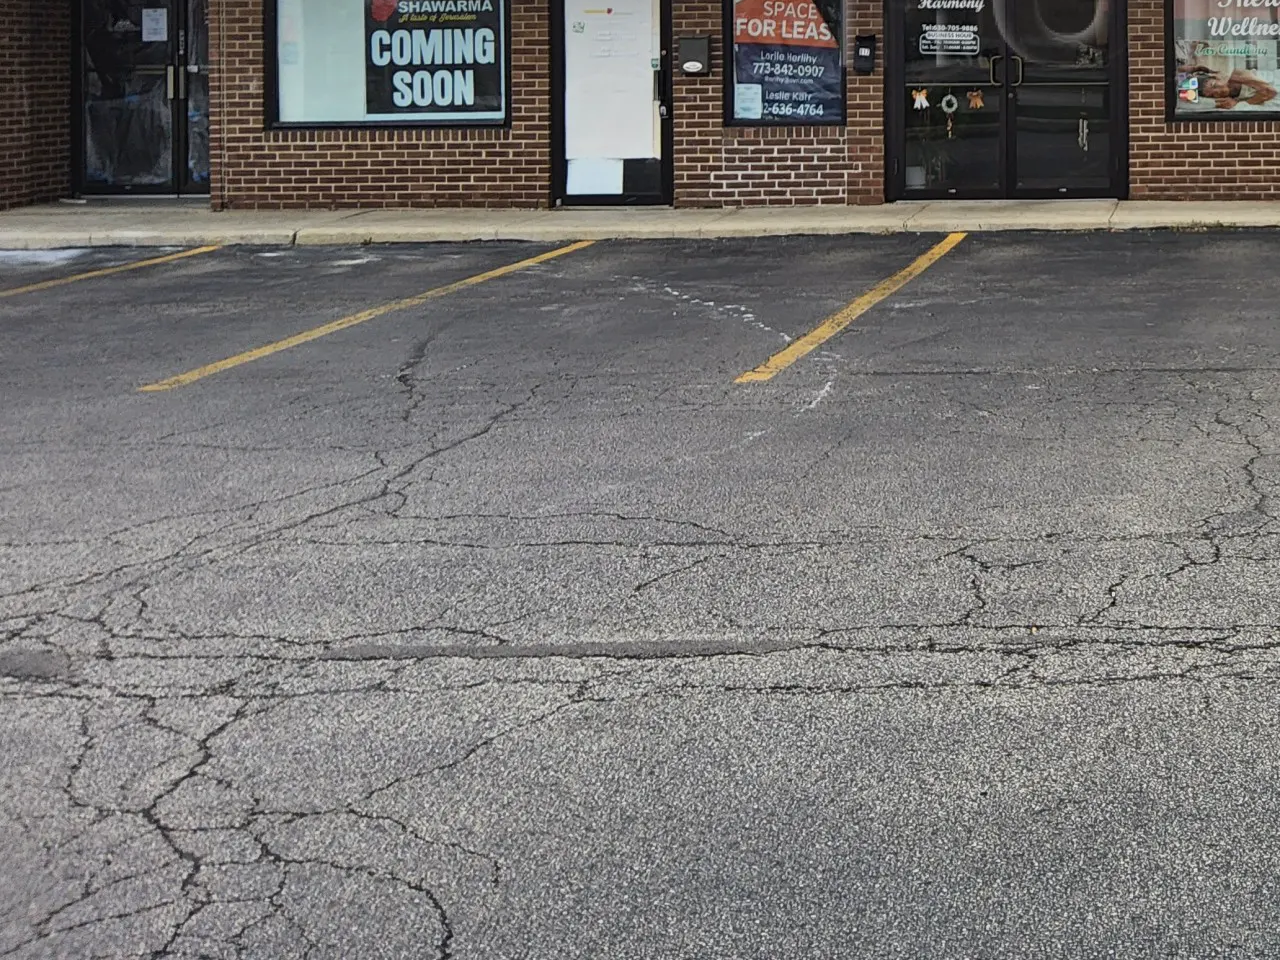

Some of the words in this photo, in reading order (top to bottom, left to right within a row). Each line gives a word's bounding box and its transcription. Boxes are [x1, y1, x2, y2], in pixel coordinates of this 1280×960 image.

[398, 0, 493, 13] SHAWARMA
[763, 0, 818, 19] SPACE
[410, 14, 429, 22] taste
[429, 14, 437, 23] of
[438, 13, 477, 22] Jerusalem
[735, 18, 776, 37] FOR
[781, 20, 835, 41] LEAS
[371, 27, 495, 66] COMING
[752, 62, 824, 78] 773-842-0907
[392, 69, 474, 107] SOON
[763, 102, 824, 116] 2-636-4764
